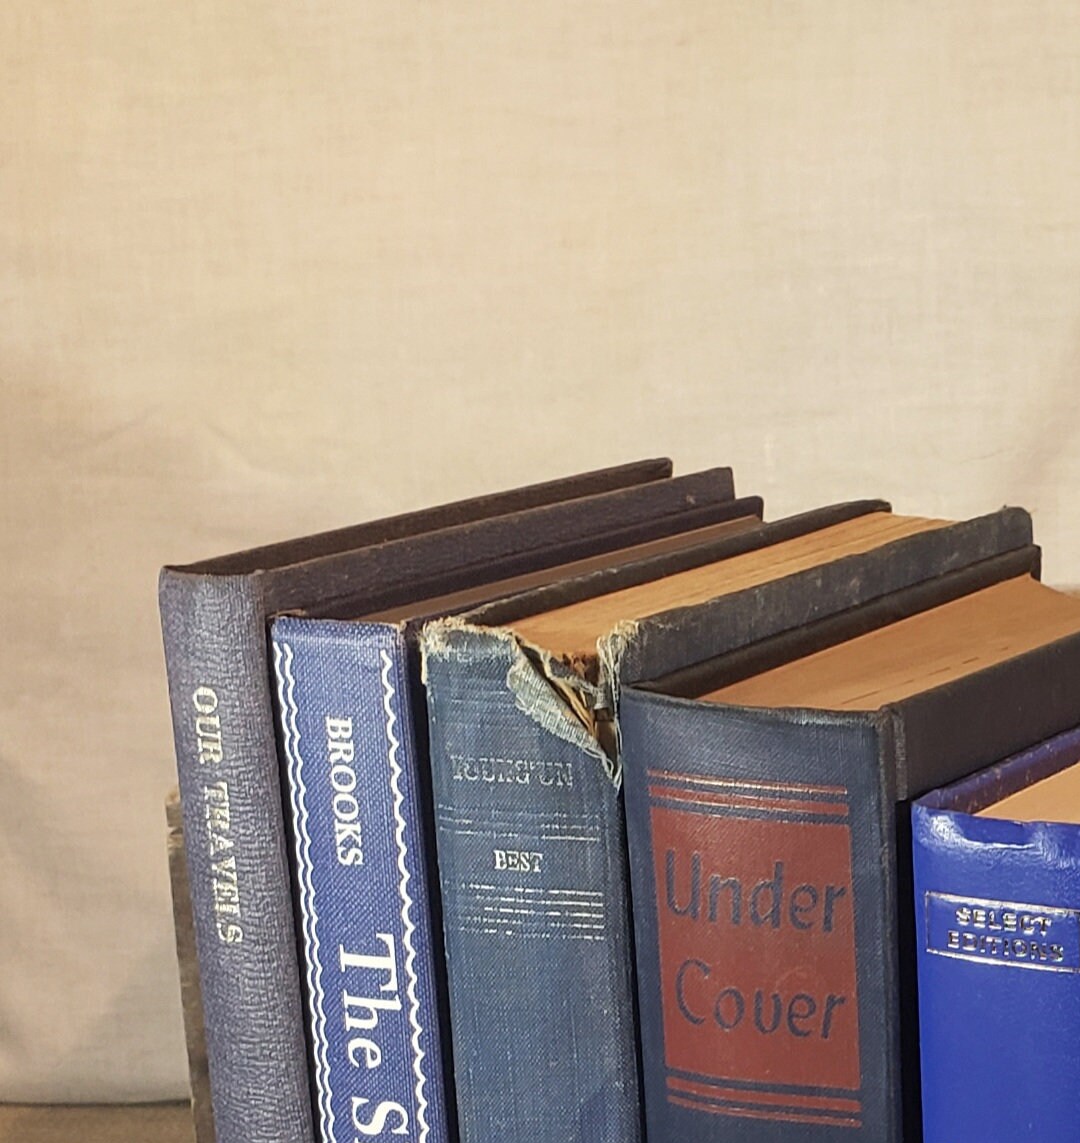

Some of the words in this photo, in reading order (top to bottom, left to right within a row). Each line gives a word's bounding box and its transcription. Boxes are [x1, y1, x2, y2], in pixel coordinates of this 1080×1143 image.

[193, 685, 224, 765] OUR
[326, 715, 364, 868] BROOKS
[203, 780, 244, 945] TRAVELS
[493, 849, 544, 873] BEST
[664, 849, 847, 933] Under
[947, 930, 1064, 963] EDITIONS
[956, 907, 1052, 937] SELECT
[340, 932, 403, 1070] The
[674, 958, 846, 1039] Cover
